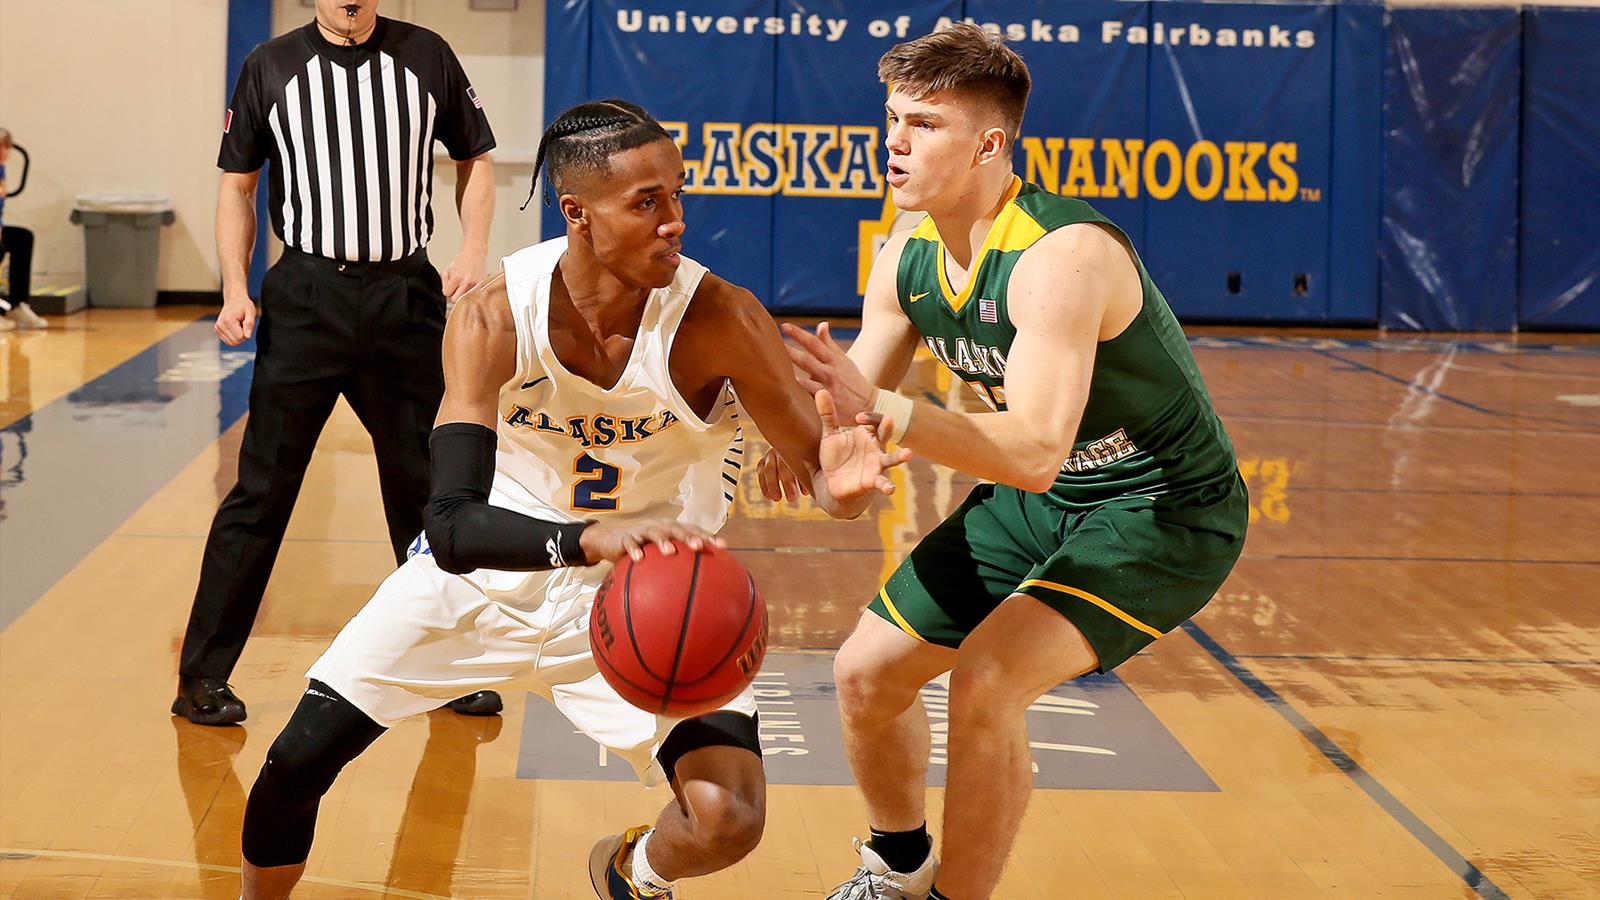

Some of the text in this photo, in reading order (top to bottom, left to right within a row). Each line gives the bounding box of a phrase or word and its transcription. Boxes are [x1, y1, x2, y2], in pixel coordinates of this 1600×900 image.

[617, 9, 848, 42] University
[867, 15, 911, 38] of
[1101, 20, 1316, 49] Fairbanks
[1021, 136, 1299, 203] NANOOKS
[503, 402, 681, 448] ALASKA
[570, 449, 623, 512] 2
